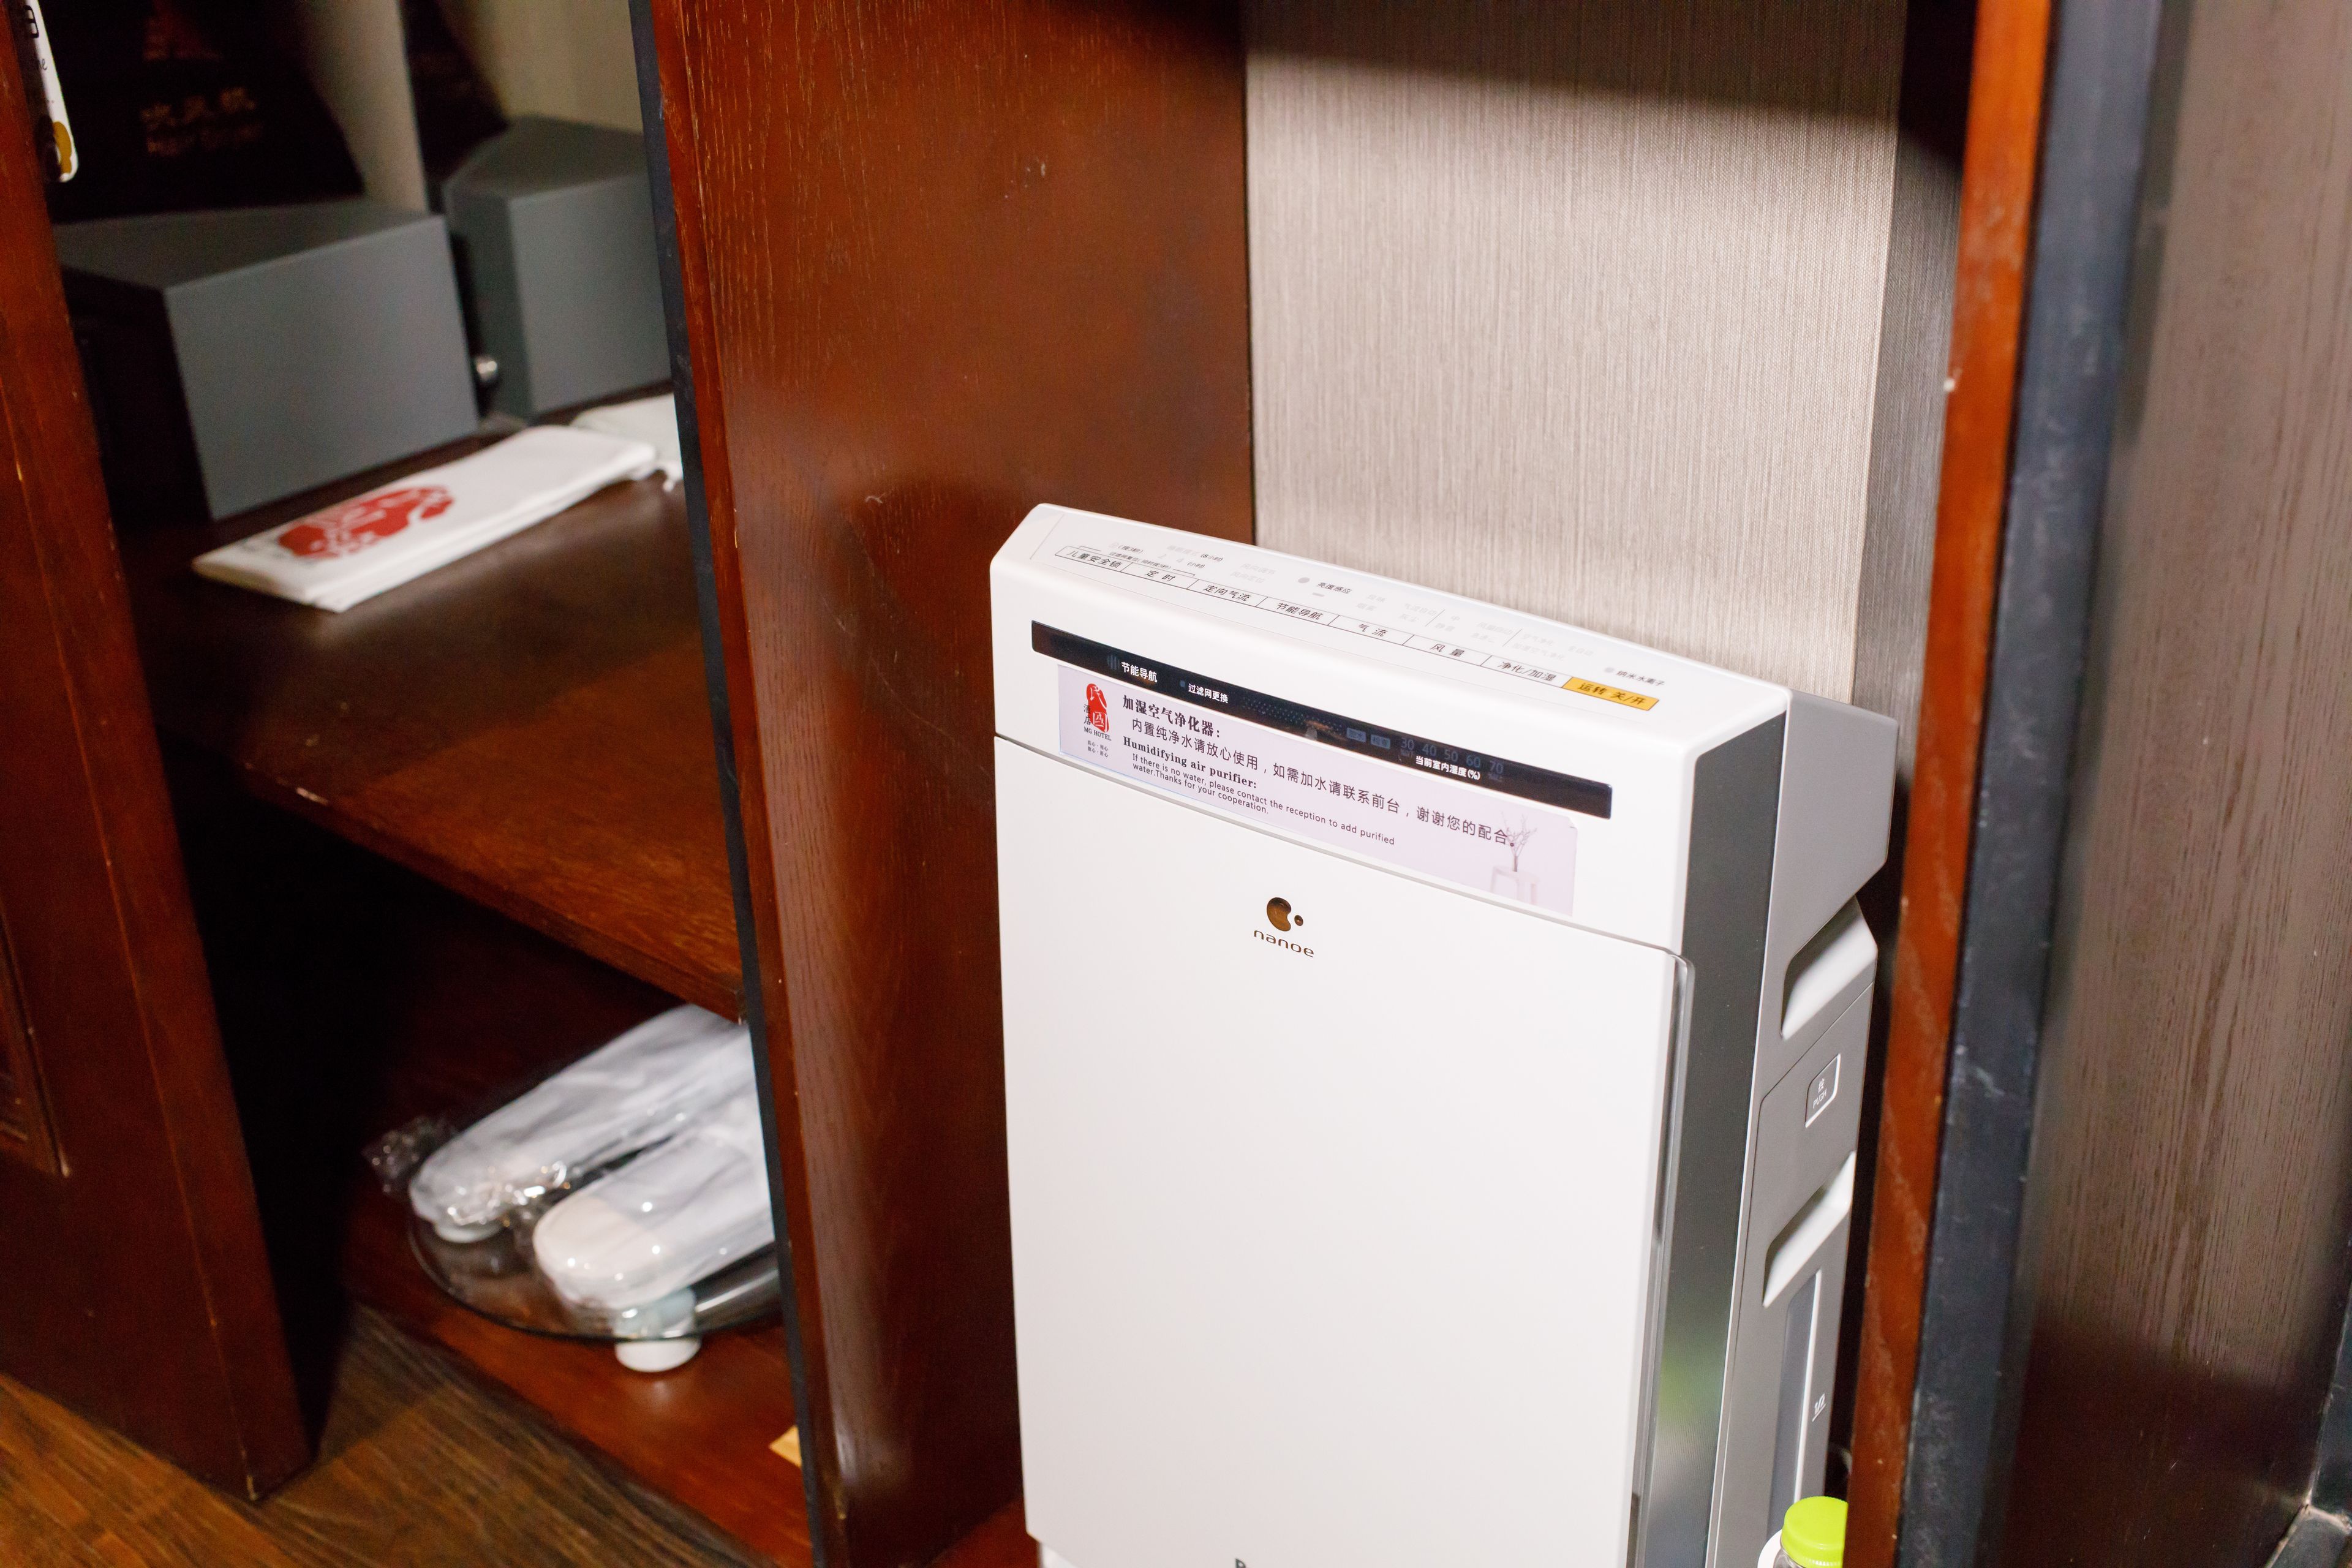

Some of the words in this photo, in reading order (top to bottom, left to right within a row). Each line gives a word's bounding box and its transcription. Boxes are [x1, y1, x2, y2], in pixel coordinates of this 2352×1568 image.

[1066, 549, 1122, 569] 儿童安全锁
[1144, 570, 1176, 582] 定时
[1203, 584, 1253, 601] 定向气流
[1316, 581, 1352, 594] 亮度感应
[1276, 602, 1324, 620] 节能导航
[1357, 623, 1389, 637] 气流
[1121, 661, 1158, 683] 节能导航
[1496, 661, 1557, 682] 净化/加湿
[1615, 669, 1666, 687] 纳米水离子
[1188, 682, 1229, 704] 过滤网更换
[1577, 681, 1605, 696] 运转
[1610, 690, 1646, 706] 关/开
[1084, 704, 1091, 725] 酒店
[1094, 730, 1112, 741] HOTEL
[1123, 736, 1187, 767] Humidifying
[1191, 761, 1205, 772] air
[1210, 767, 1256, 788] purifier:
[1401, 736, 1414, 750] 30
[1422, 743, 1437, 756] 40
[1444, 749, 1459, 762] 50
[1466, 755, 1481, 768] 60
[1490, 760, 1504, 774] 70
[1415, 755, 1481, 781] 当前室内湿度(%)
[1140, 757, 1159, 769] there
[1183, 773, 1206, 785] water,
[1209, 780, 1234, 794] please
[1237, 790, 1267, 805] contact
[1270, 800, 1283, 810] the
[1286, 805, 1325, 824] reception
[1329, 819, 1338, 827] to
[1341, 823, 1357, 833] add
[1360, 829, 1395, 845] purified
[1185, 780, 1195, 789] for
[1198, 786, 1216, 796] your
[1218, 793, 1268, 814] cooperation.
[1254, 930, 1314, 958] nanoe
[1813, 1088, 1827, 1109] PUSH
